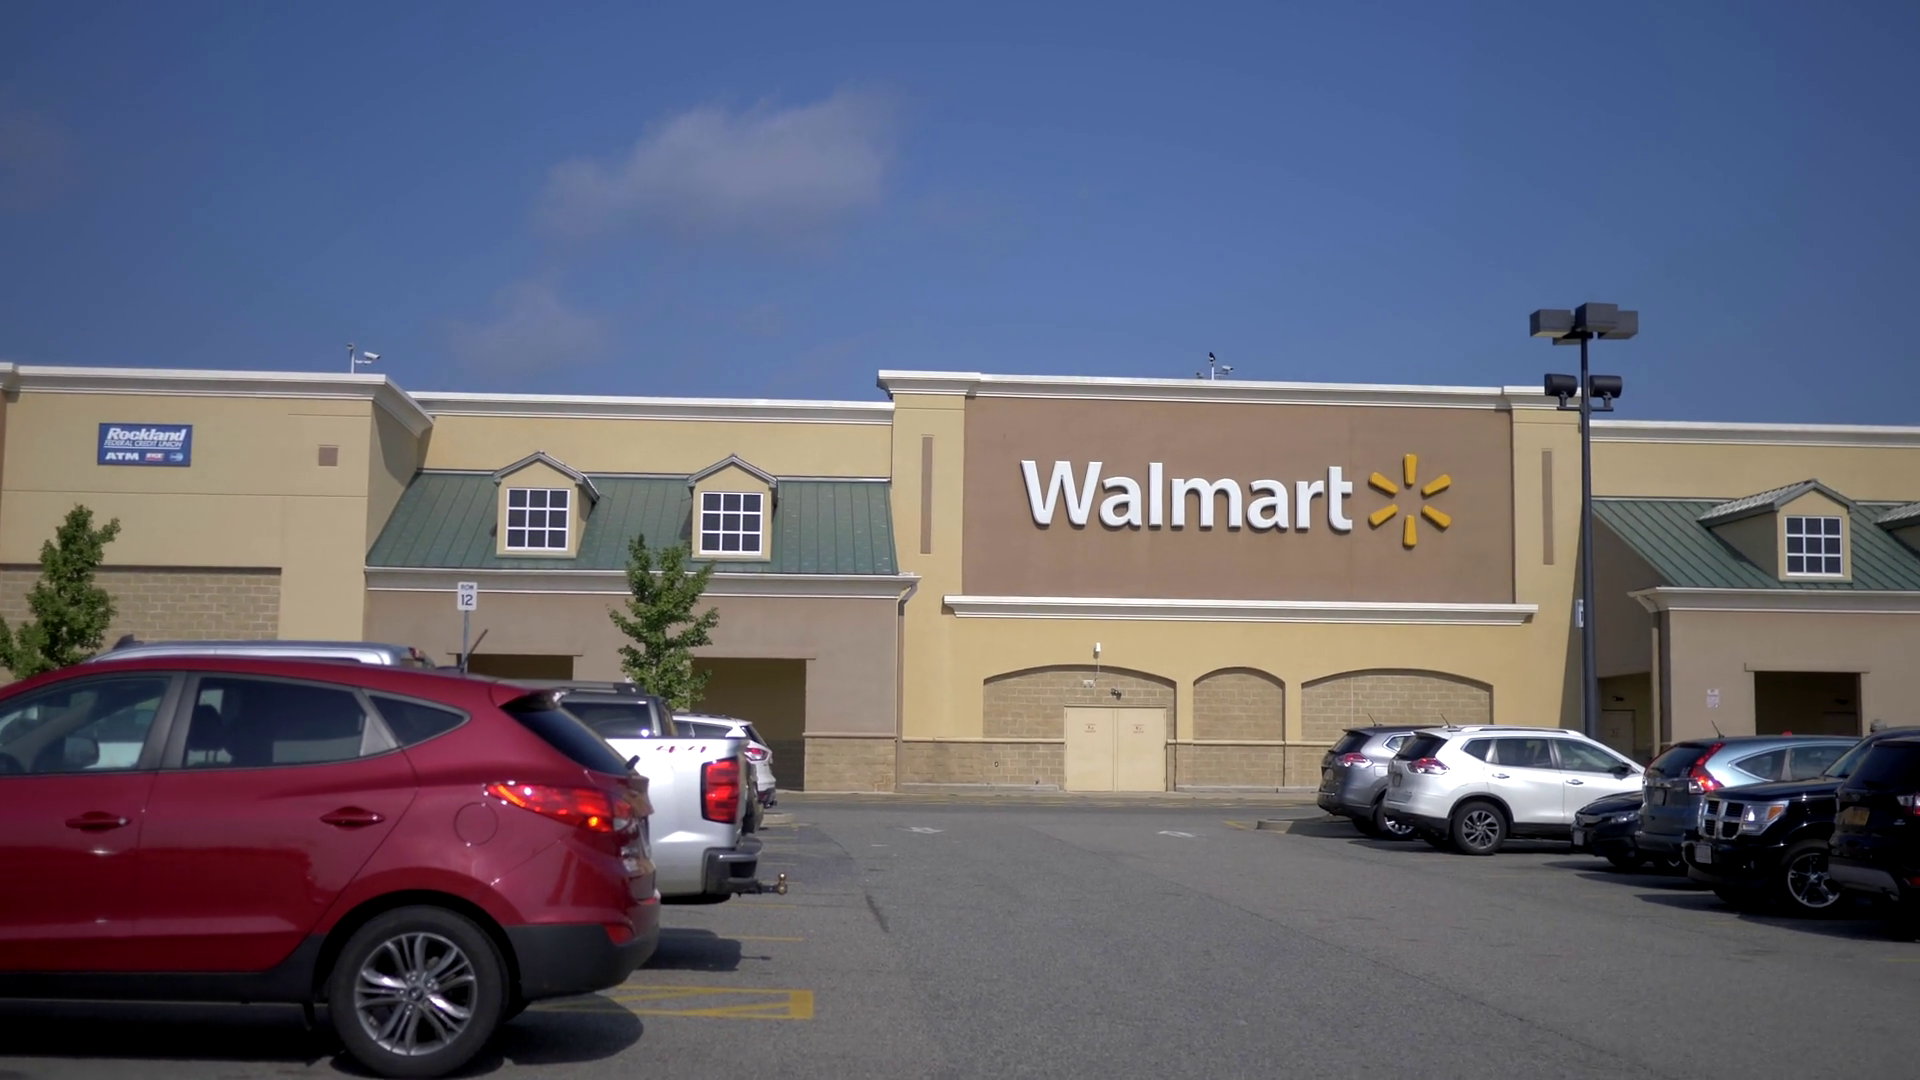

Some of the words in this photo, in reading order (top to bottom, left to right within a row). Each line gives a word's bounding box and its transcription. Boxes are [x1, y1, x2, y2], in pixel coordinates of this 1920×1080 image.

[106, 427, 187, 441] Rockland
[104, 439, 133, 447] FEDERAL
[105, 452, 139, 460] ATM
[1021, 460, 1353, 532] Walmart
[461, 594, 474, 606] 12
[656, 745, 707, 753] 44
